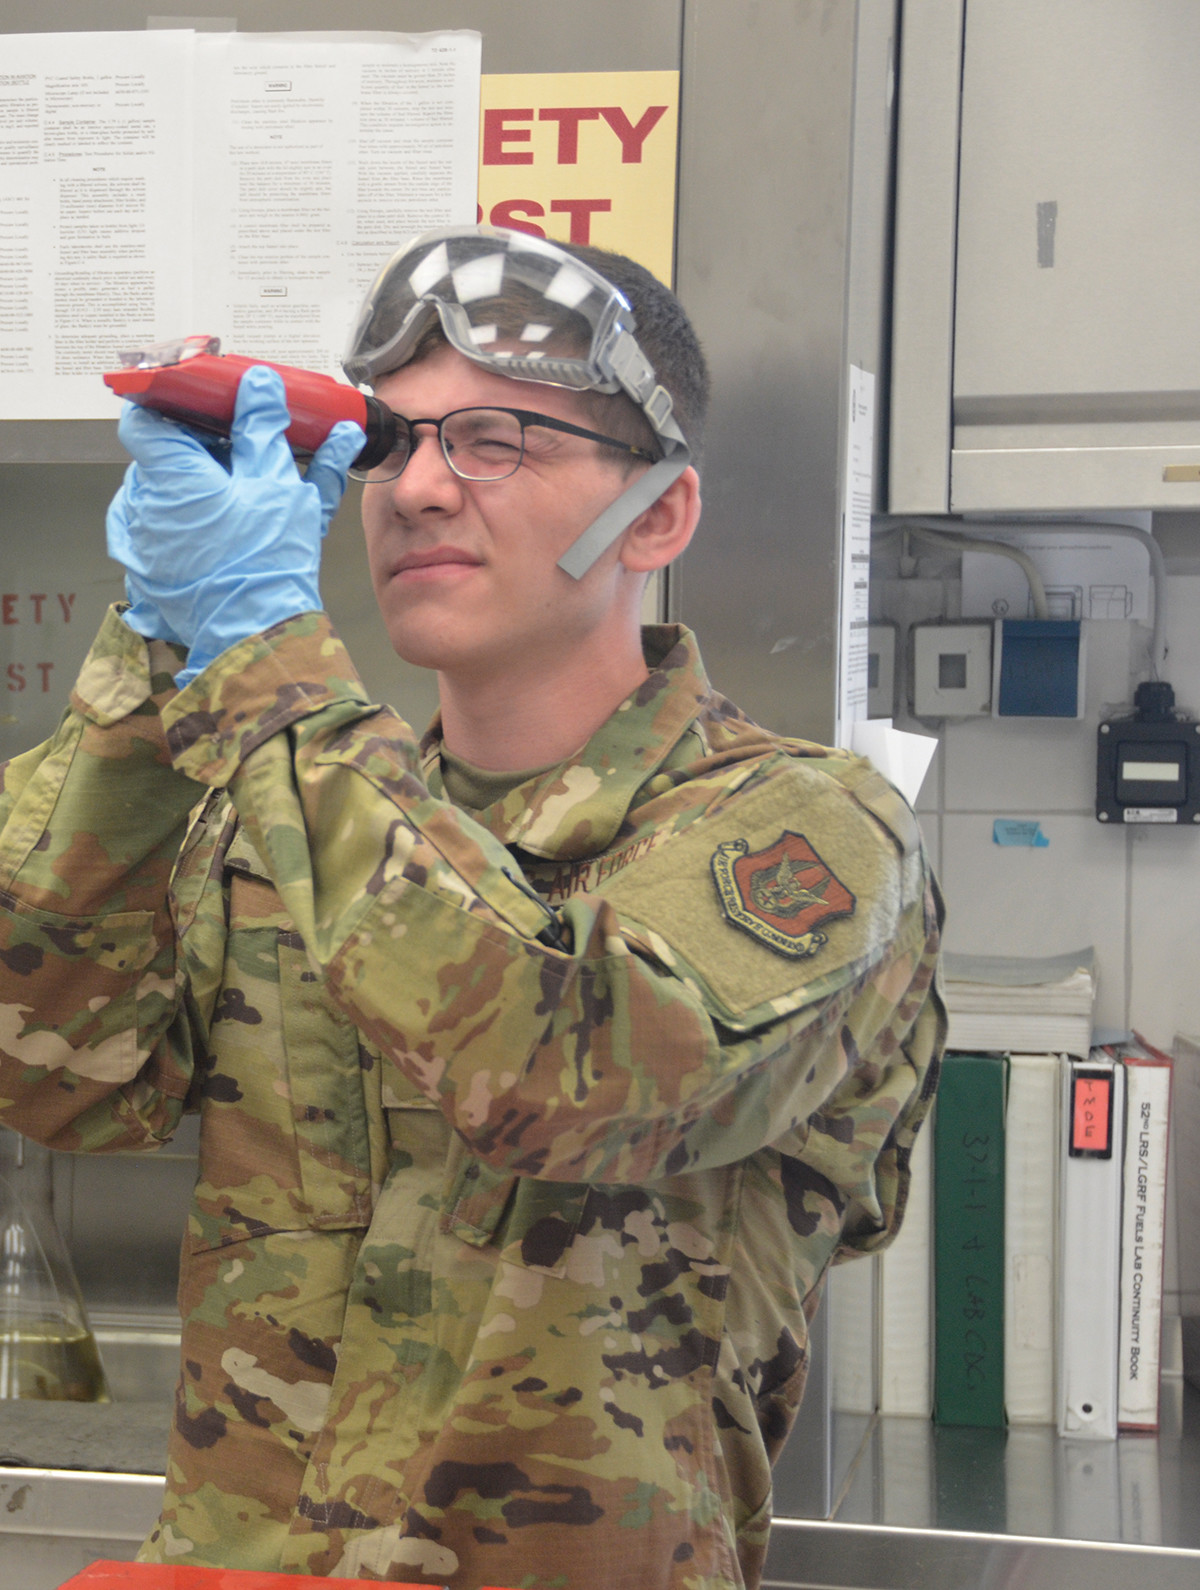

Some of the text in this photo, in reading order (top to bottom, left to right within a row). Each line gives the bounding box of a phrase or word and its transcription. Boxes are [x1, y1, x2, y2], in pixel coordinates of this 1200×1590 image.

[482, 105, 669, 166] ETY
[547, 863, 591, 902] AIR
[1136, 1131, 1150, 1203] LRS/LGRF
